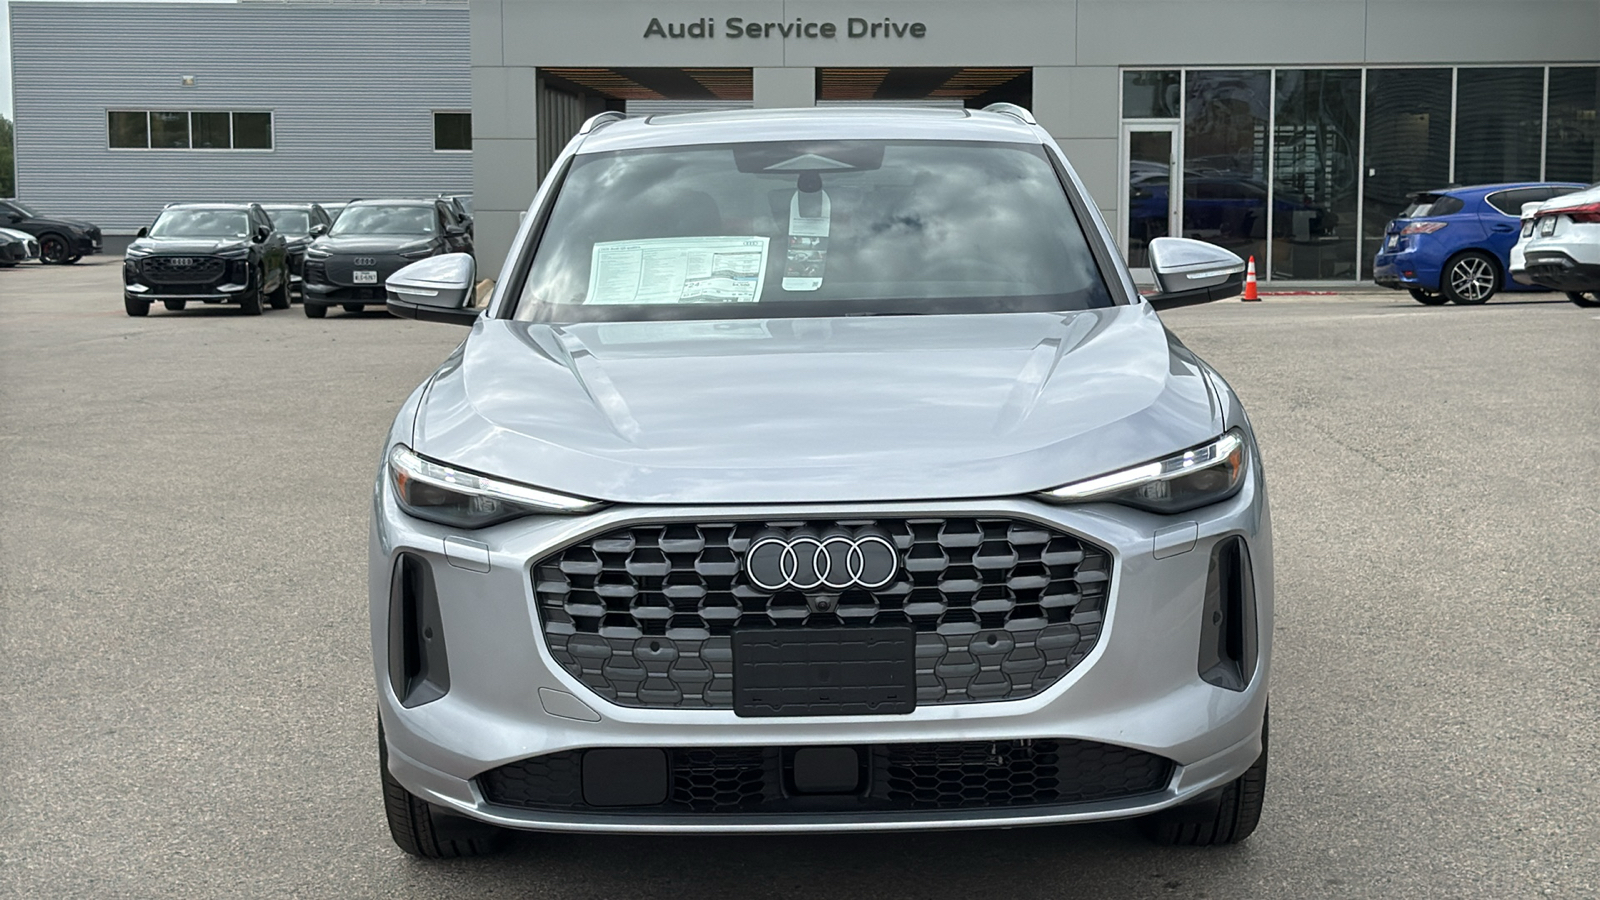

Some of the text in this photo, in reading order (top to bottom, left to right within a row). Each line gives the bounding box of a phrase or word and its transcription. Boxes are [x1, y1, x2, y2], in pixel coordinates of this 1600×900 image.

[643, 17, 927, 39] Audi Service Drive
